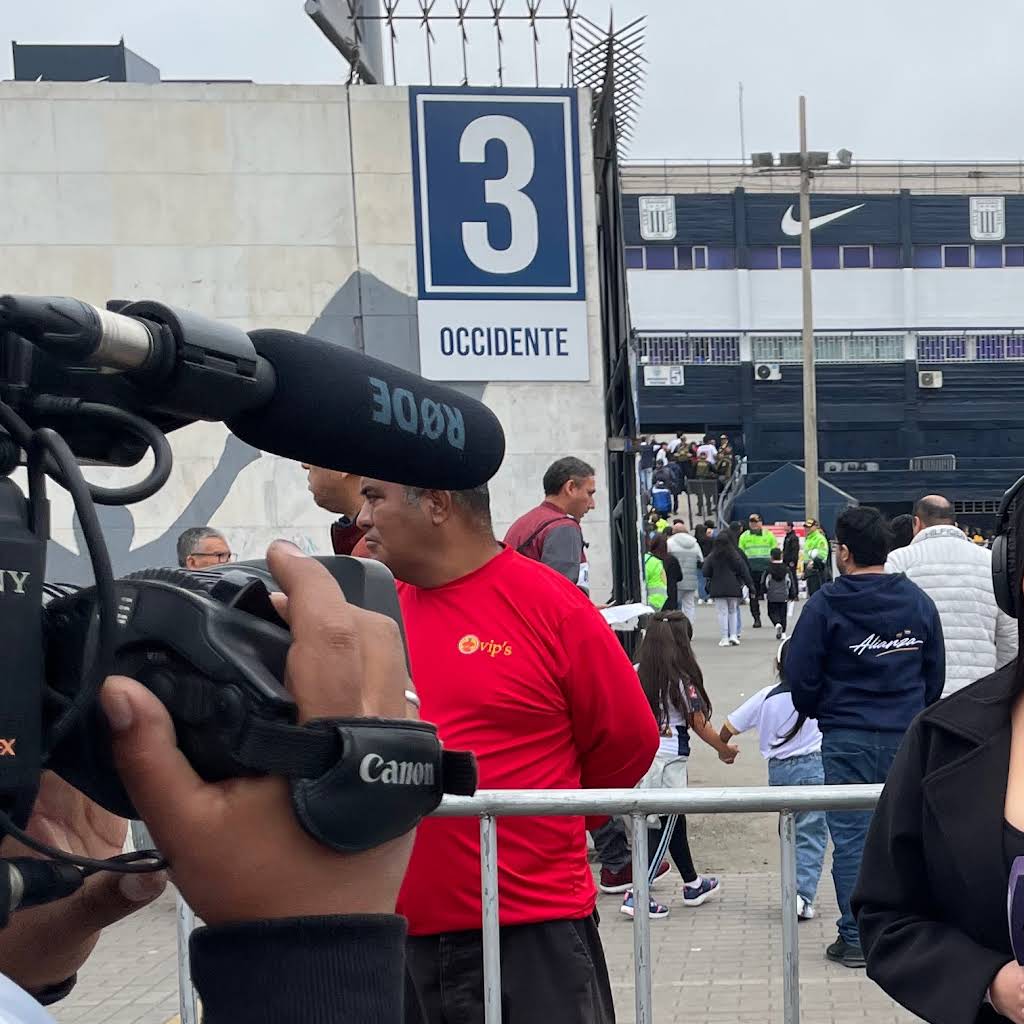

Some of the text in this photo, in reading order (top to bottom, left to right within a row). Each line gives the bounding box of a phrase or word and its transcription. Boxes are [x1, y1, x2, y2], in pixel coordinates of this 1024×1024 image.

[459, 114, 539, 275] 3
[440, 326, 569, 356] OCCIDENTE
[671, 370, 681, 384] 5
[480, 640, 512, 657] vip's
[849, 633, 924, 655] Alianza
[359, 753, 434, 785] Canon
